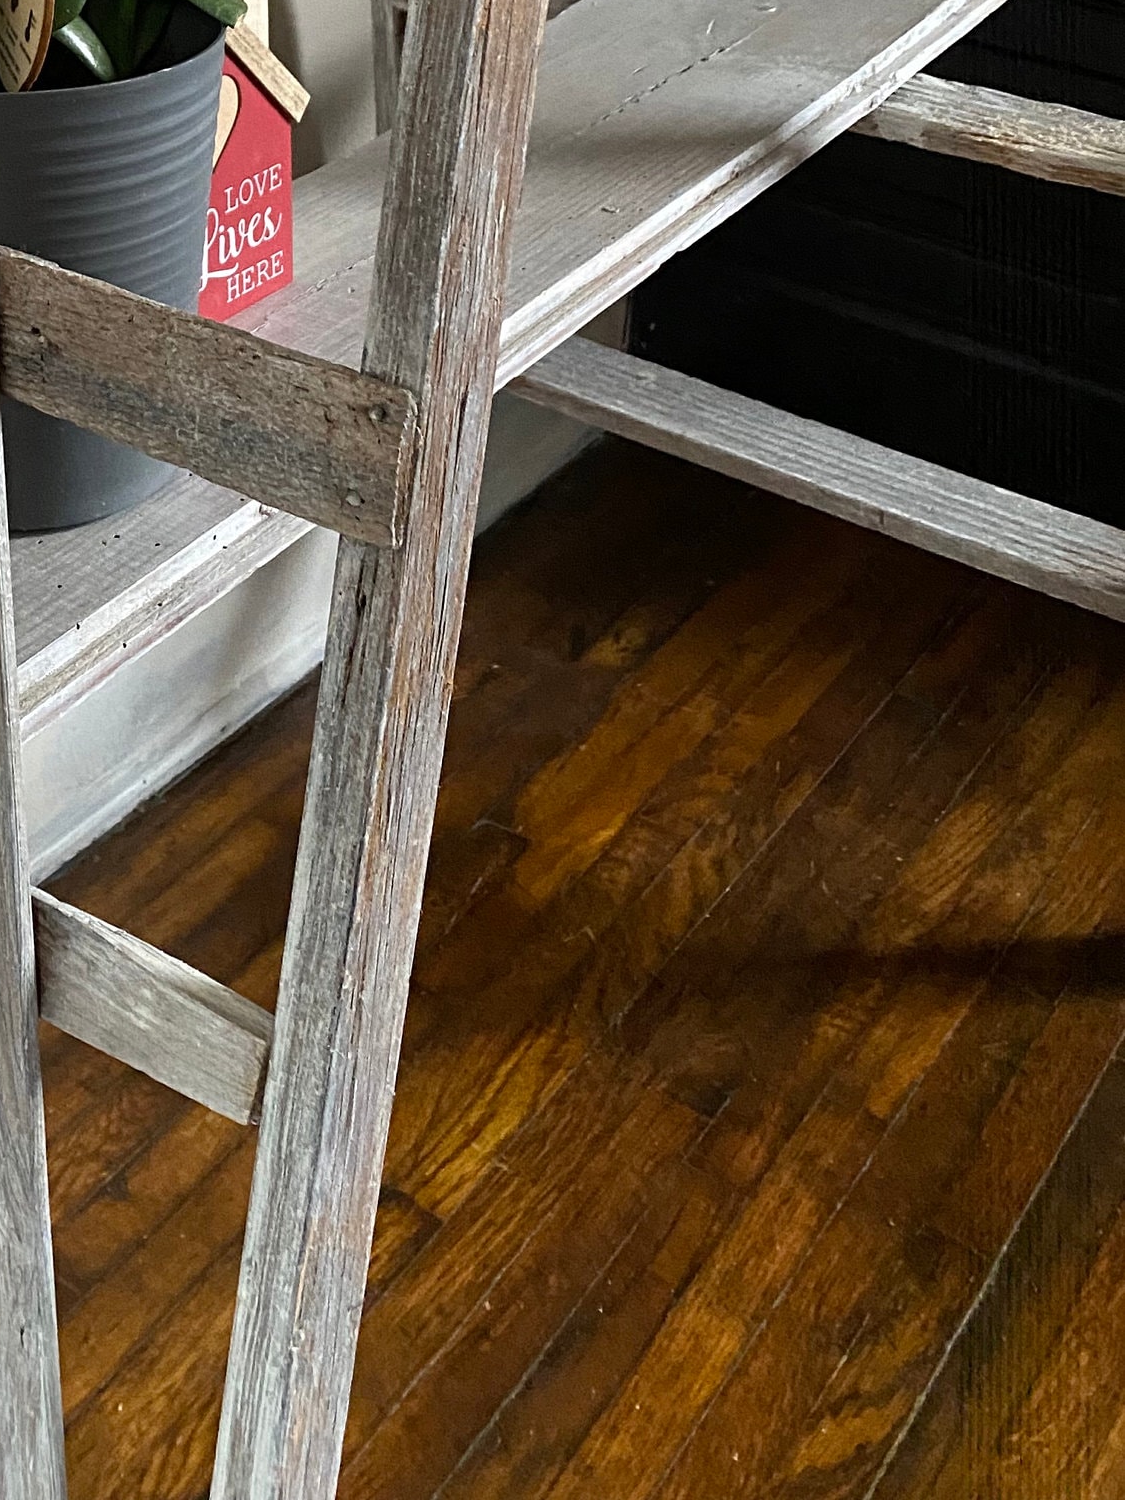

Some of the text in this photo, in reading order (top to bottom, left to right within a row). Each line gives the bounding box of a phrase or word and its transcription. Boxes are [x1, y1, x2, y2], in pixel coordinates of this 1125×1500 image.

[224, 163, 282, 214] LOVE
[199, 206, 283, 292] Lives
[226, 250, 284, 303] HERE
